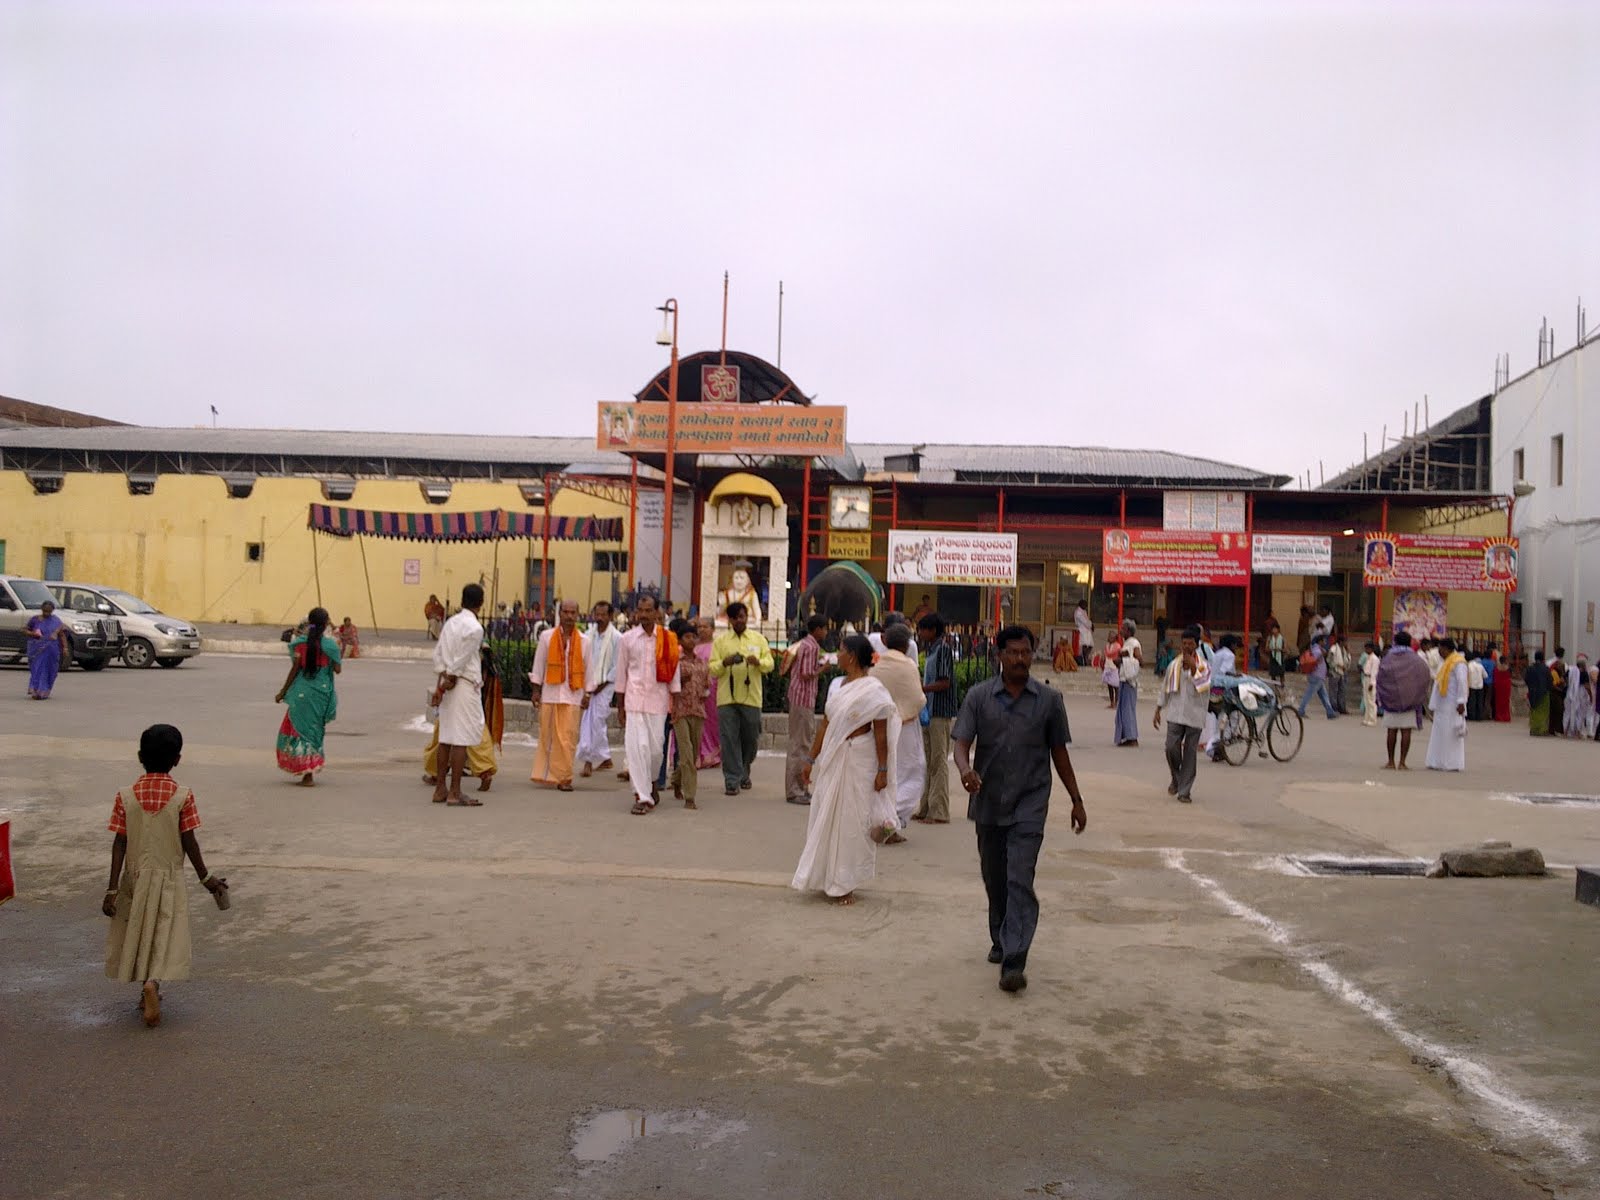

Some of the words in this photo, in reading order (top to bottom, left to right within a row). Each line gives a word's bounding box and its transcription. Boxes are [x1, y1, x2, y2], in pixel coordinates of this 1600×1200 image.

[830, 548, 869, 557] WATCHES
[935, 563, 957, 574] VISIT
[958, 564, 969, 574] TO
[971, 565, 1012, 576] GOUSHALA
